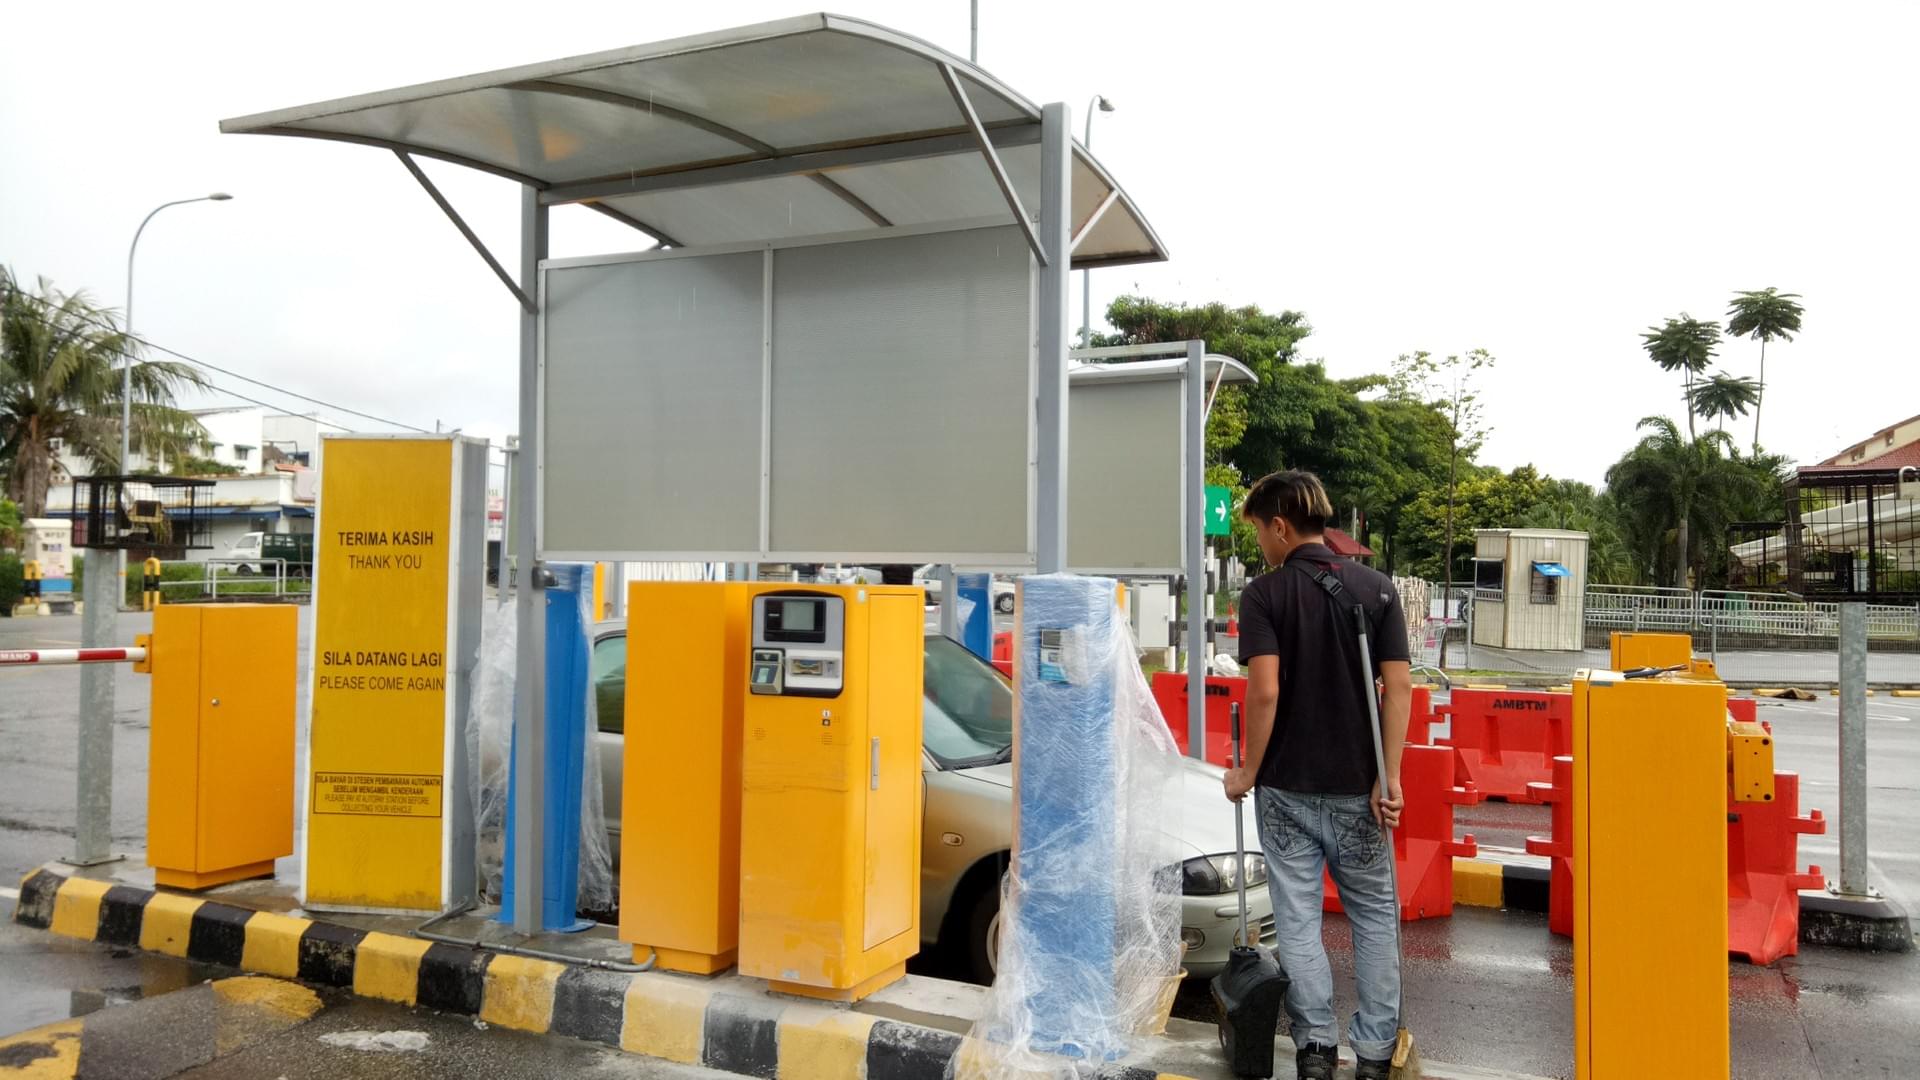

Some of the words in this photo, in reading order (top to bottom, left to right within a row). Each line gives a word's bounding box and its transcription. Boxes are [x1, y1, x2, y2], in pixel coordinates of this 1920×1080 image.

[338, 531, 388, 546] TERIMA
[392, 531, 433, 546] KASIH
[348, 554, 391, 569] THANK
[394, 554, 422, 569] YOU
[323, 651, 352, 666] SILA
[356, 651, 407, 666] DATANG
[411, 652, 442, 667] LAGI
[320, 675, 365, 690] PLEASE
[369, 676, 404, 690] COME
[407, 677, 444, 691] AGAIN
[1492, 698, 1547, 711] AMBTM
